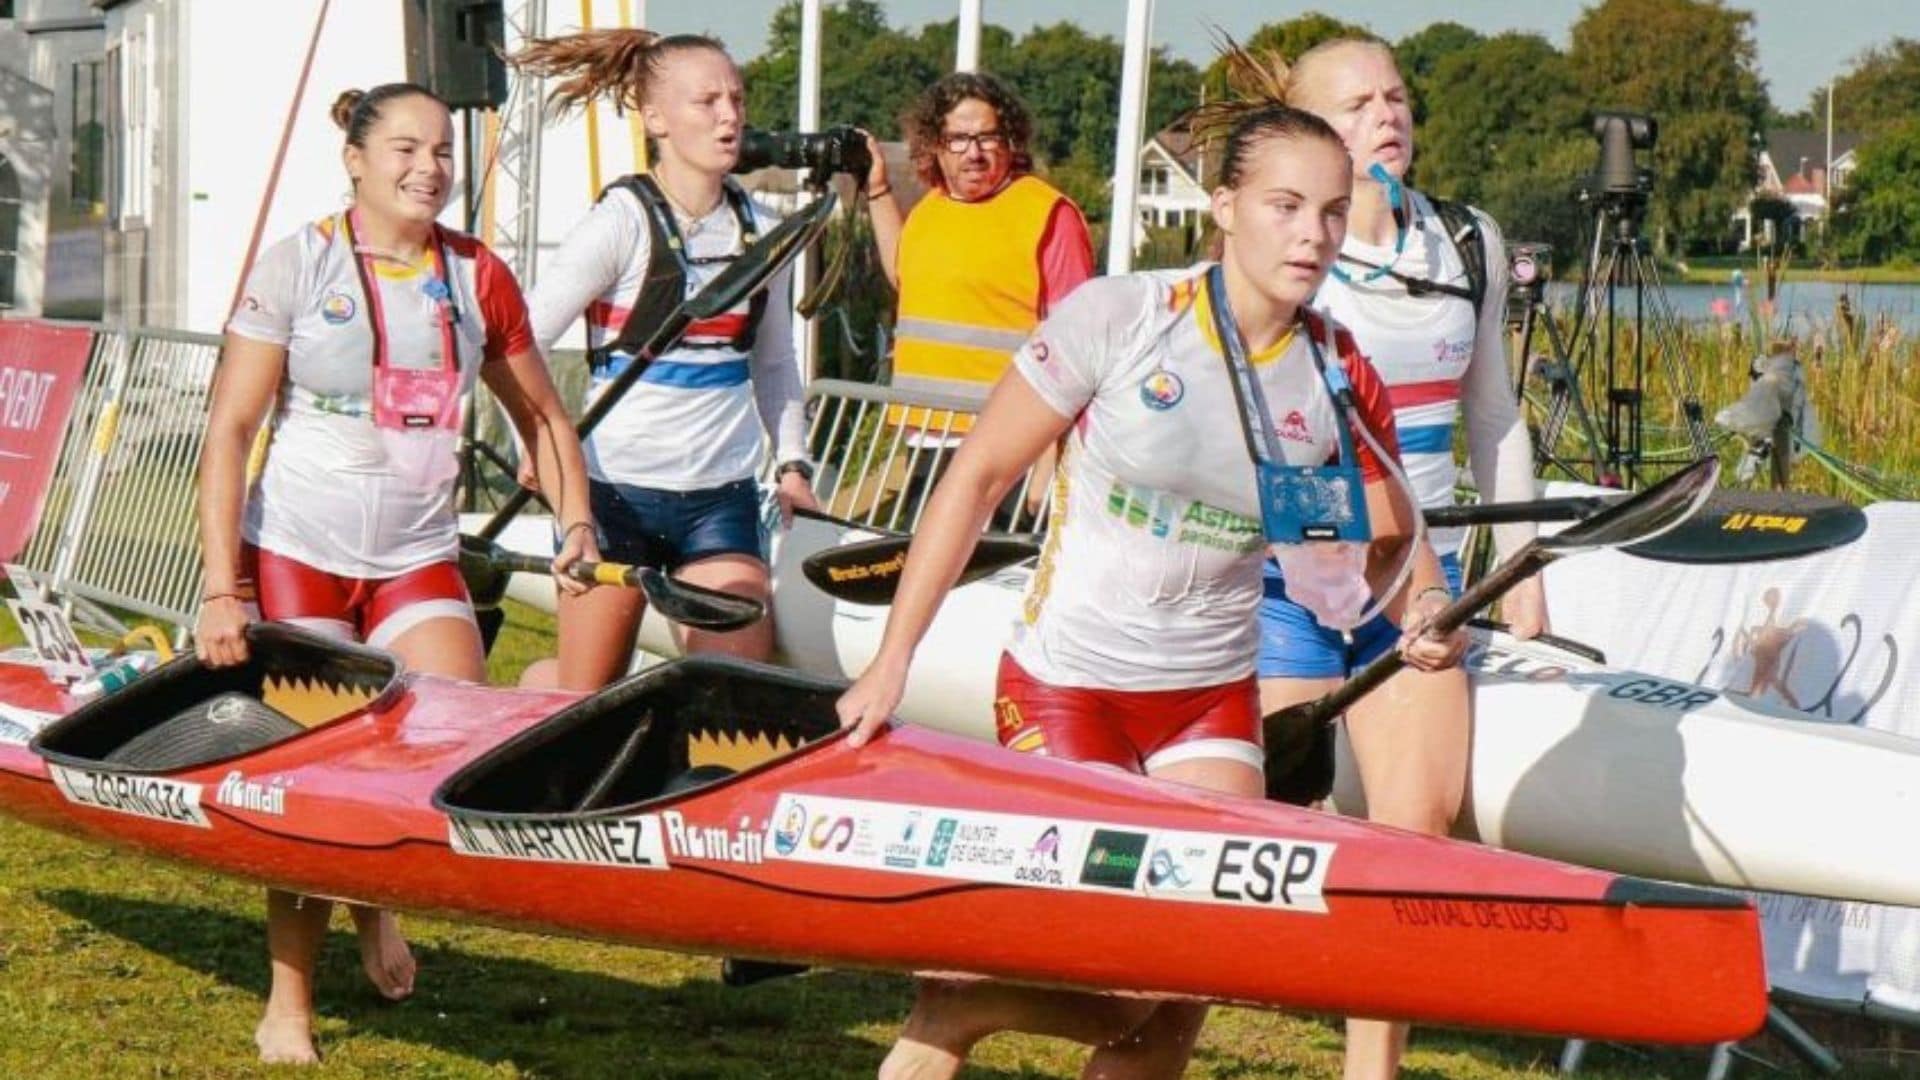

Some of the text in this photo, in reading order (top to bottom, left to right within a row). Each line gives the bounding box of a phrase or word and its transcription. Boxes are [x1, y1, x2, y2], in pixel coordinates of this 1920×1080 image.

[1608, 680, 1718, 710] GBR
[86, 771, 200, 823] ZORNOZA
[484, 816, 651, 864] MARTINEZ
[1212, 839, 1318, 904] ESP
[1391, 897, 1569, 933] FLUVIAL DE LUGO
